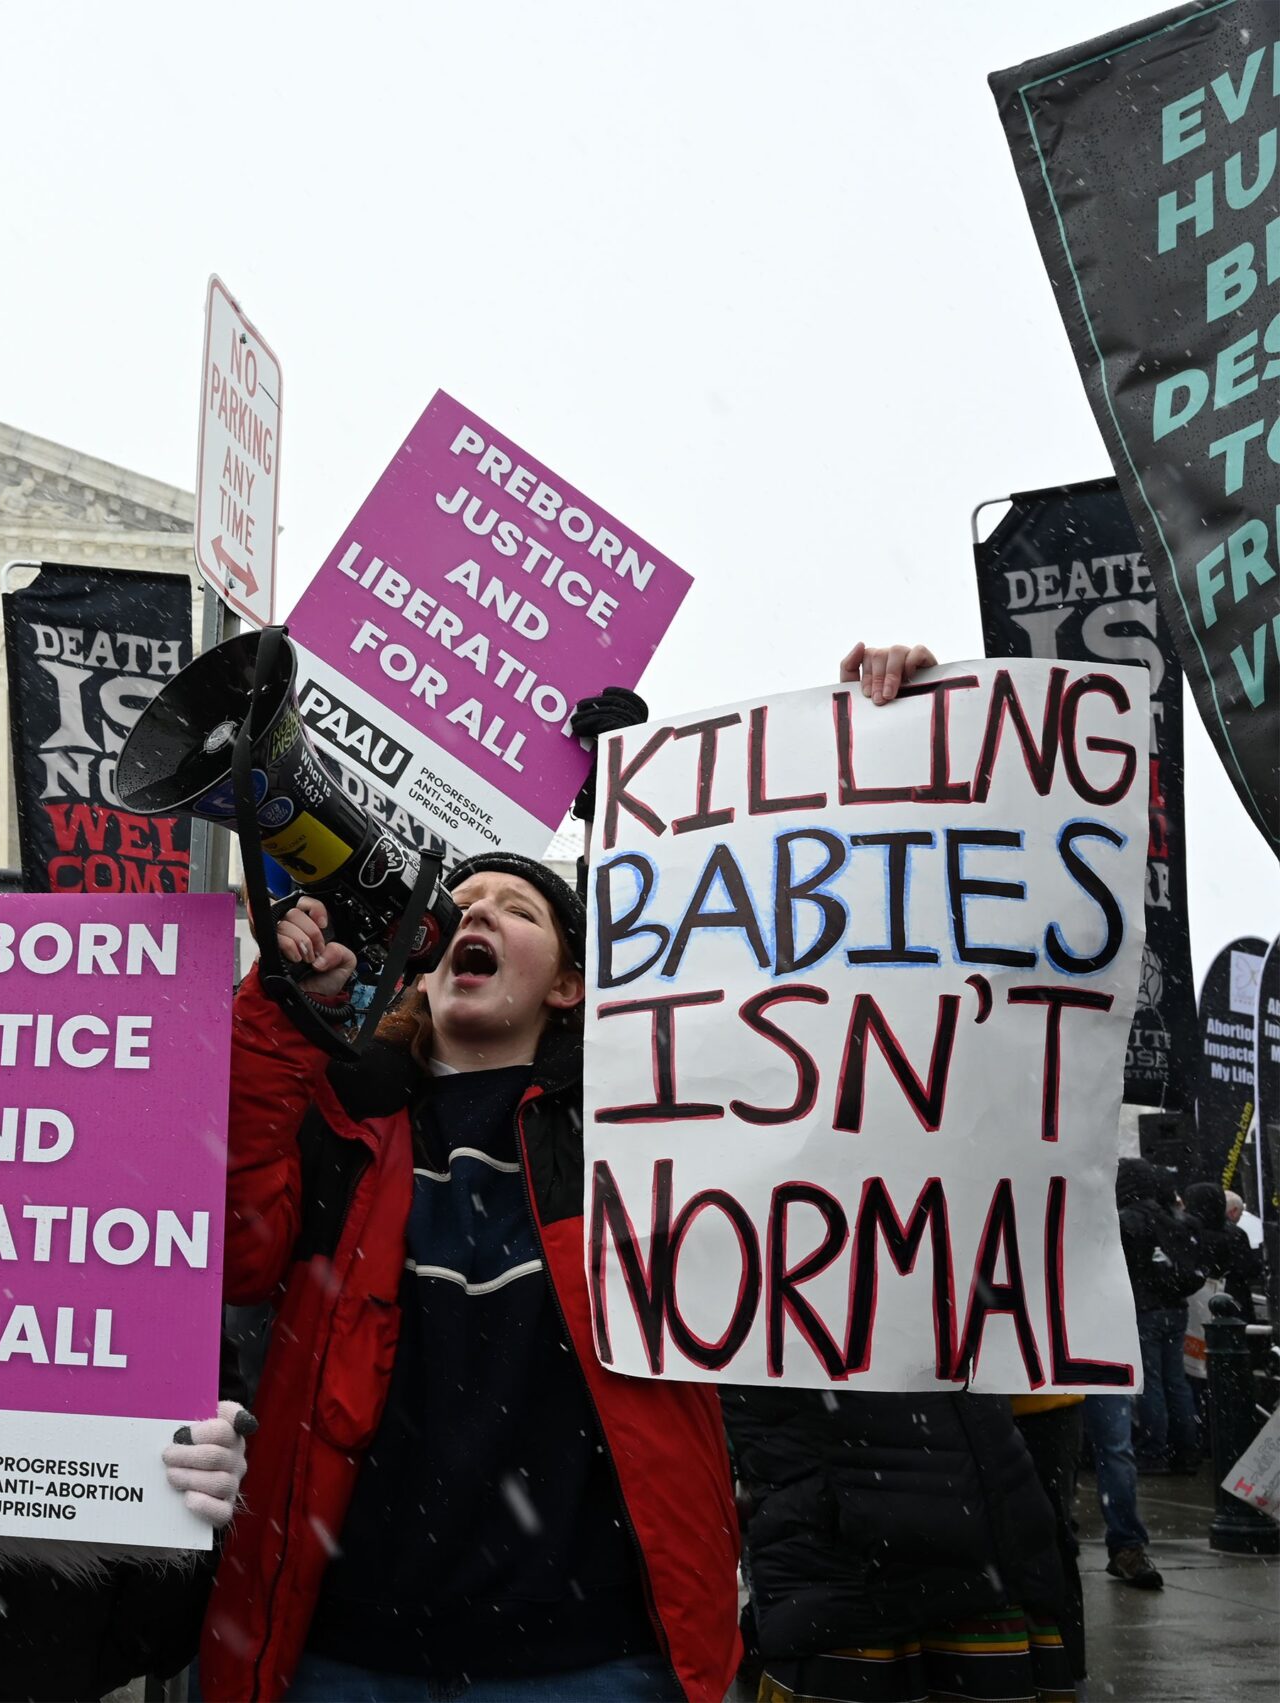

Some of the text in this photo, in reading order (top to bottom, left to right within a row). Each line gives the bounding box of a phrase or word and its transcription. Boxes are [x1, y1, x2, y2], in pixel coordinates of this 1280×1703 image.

[1162, 40, 1280, 165] EV
[1158, 127, 1278, 255] HU
[230, 328, 257, 398] NO
[210, 362, 273, 475] PARKING
[222, 446, 255, 506] ANY
[449, 425, 656, 591] PREBORN
[219, 485, 255, 556] TIME
[436, 486, 619, 629] JUSTICE
[444, 559, 549, 641] AND
[29, 622, 182, 676] DEATH
[300, 687, 405, 776] PAAU
[350, 620, 527, 773] FOR ALL
[292, 768, 325, 808] 2,363?
[300, 747, 326, 787] What
[323, 782, 332, 797] is
[420, 767, 494, 825] PROGRESSIVE
[603, 668, 1138, 850] KILLING
[408, 788, 459, 830] UPRISING
[414, 779, 501, 846] ANTI-ABORTION
[596, 818, 1130, 988] BABIES
[594, 973, 1114, 1142] ISN'T
[1204, 1039, 1254, 1063] Impacte
[1207, 1018, 1254, 1042] Abortio
[1211, 1062, 1230, 1083] My
[590, 1158, 1135, 1391] NORMAL
